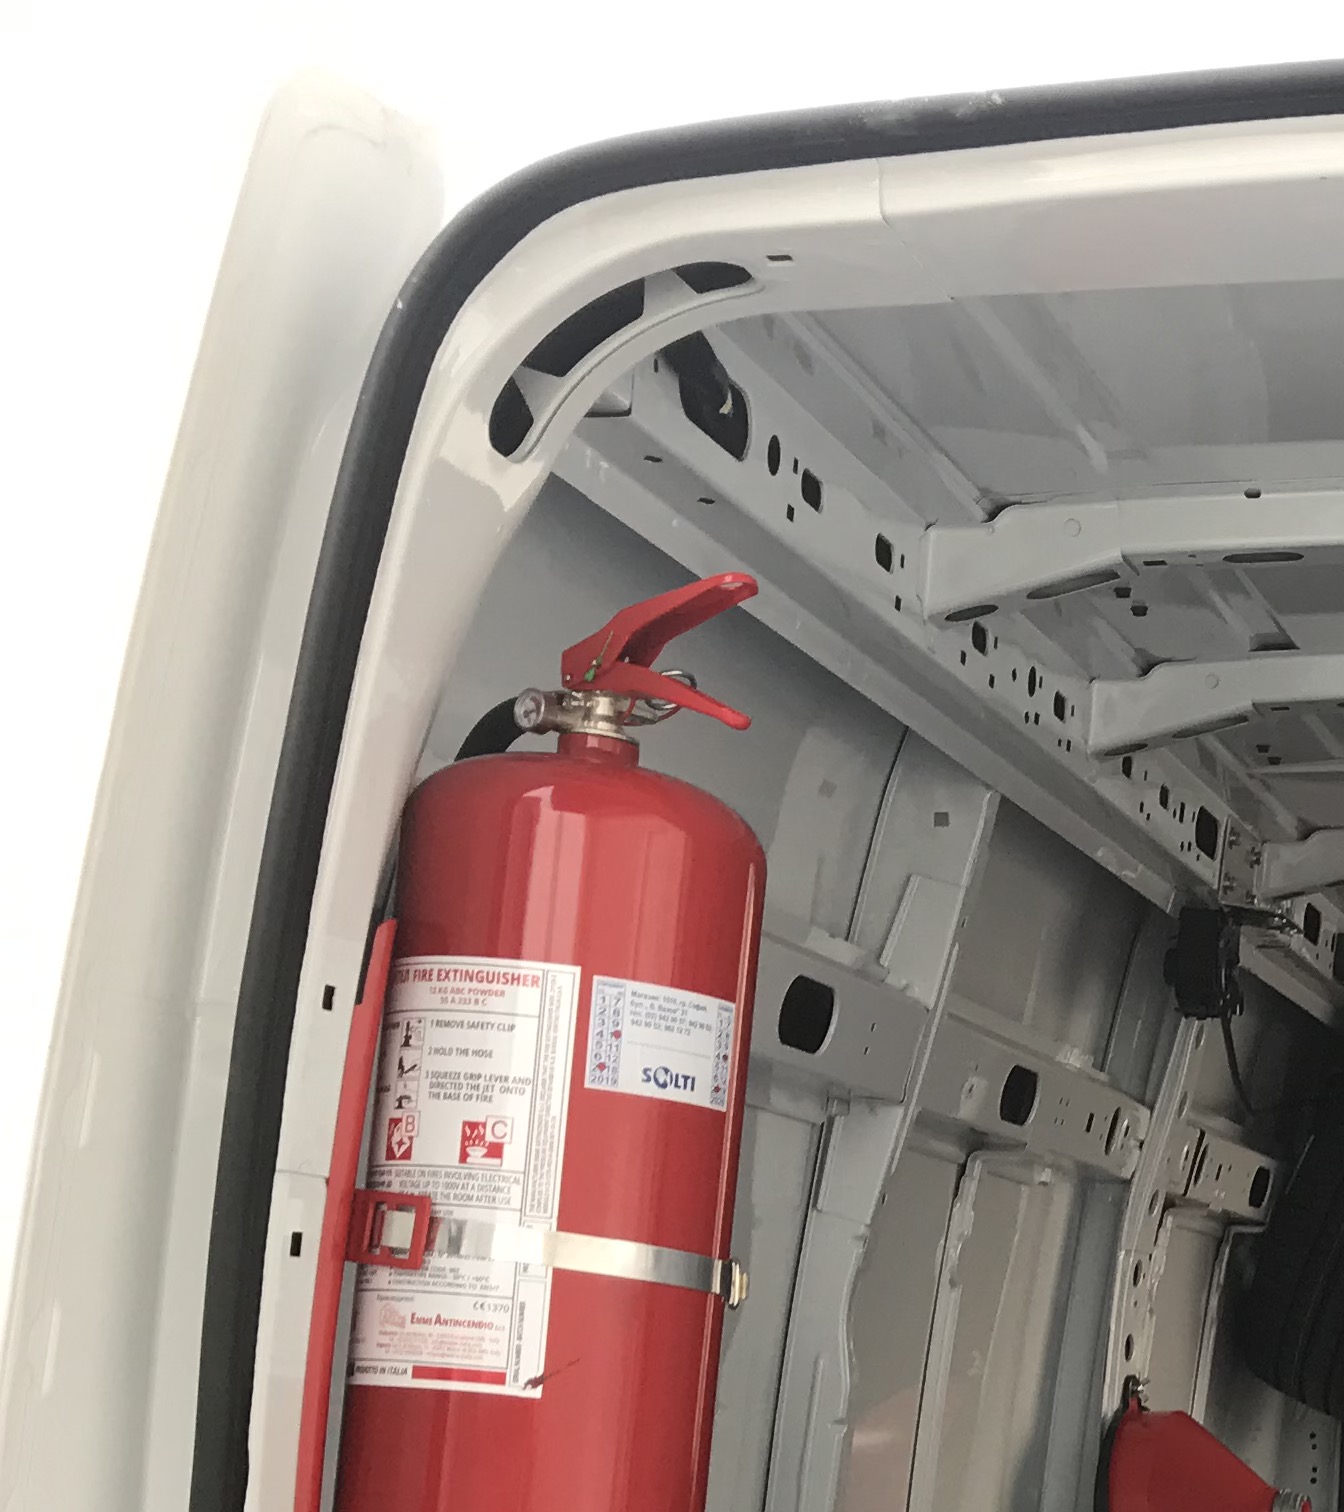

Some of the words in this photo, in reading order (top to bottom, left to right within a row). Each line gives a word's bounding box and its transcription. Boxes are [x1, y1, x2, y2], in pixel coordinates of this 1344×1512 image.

[413, 968, 434, 983] FIRE
[436, 968, 541, 988] EXTINGUISHER
[467, 988, 506, 998] POWDER
[435, 1019, 465, 1029] REMOVE
[466, 1020, 495, 1031] SAFETY
[496, 1022, 516, 1032] CLIP
[433, 1047, 454, 1056] HOLD
[455, 1047, 470, 1057] THE
[471, 1048, 493, 1059] HOSE
[430, 1070, 461, 1080] SQUEEZE
[463, 1072, 482, 1081] GRIP
[483, 1073, 509, 1084] LEVER
[511, 1076, 532, 1086] AND
[429, 1081, 464, 1090] DIRECTED
[466, 1082, 480, 1092] THE
[482, 1084, 496, 1094] JET
[499, 1085, 526, 1096] ONTO
[428, 1091, 441, 1100] THE
[443, 1091, 461, 1101] BASE
[463, 1092, 474, 1101] OF
[475, 1094, 493, 1103] FIRE
[404, 1115, 415, 1133] B
[491, 1120, 508, 1140] C
[481, 1172, 521, 1185] ELECTRICAL
[477, 1183, 511, 1194] DISTANCE
[475, 1193, 497, 1204] AFTER
